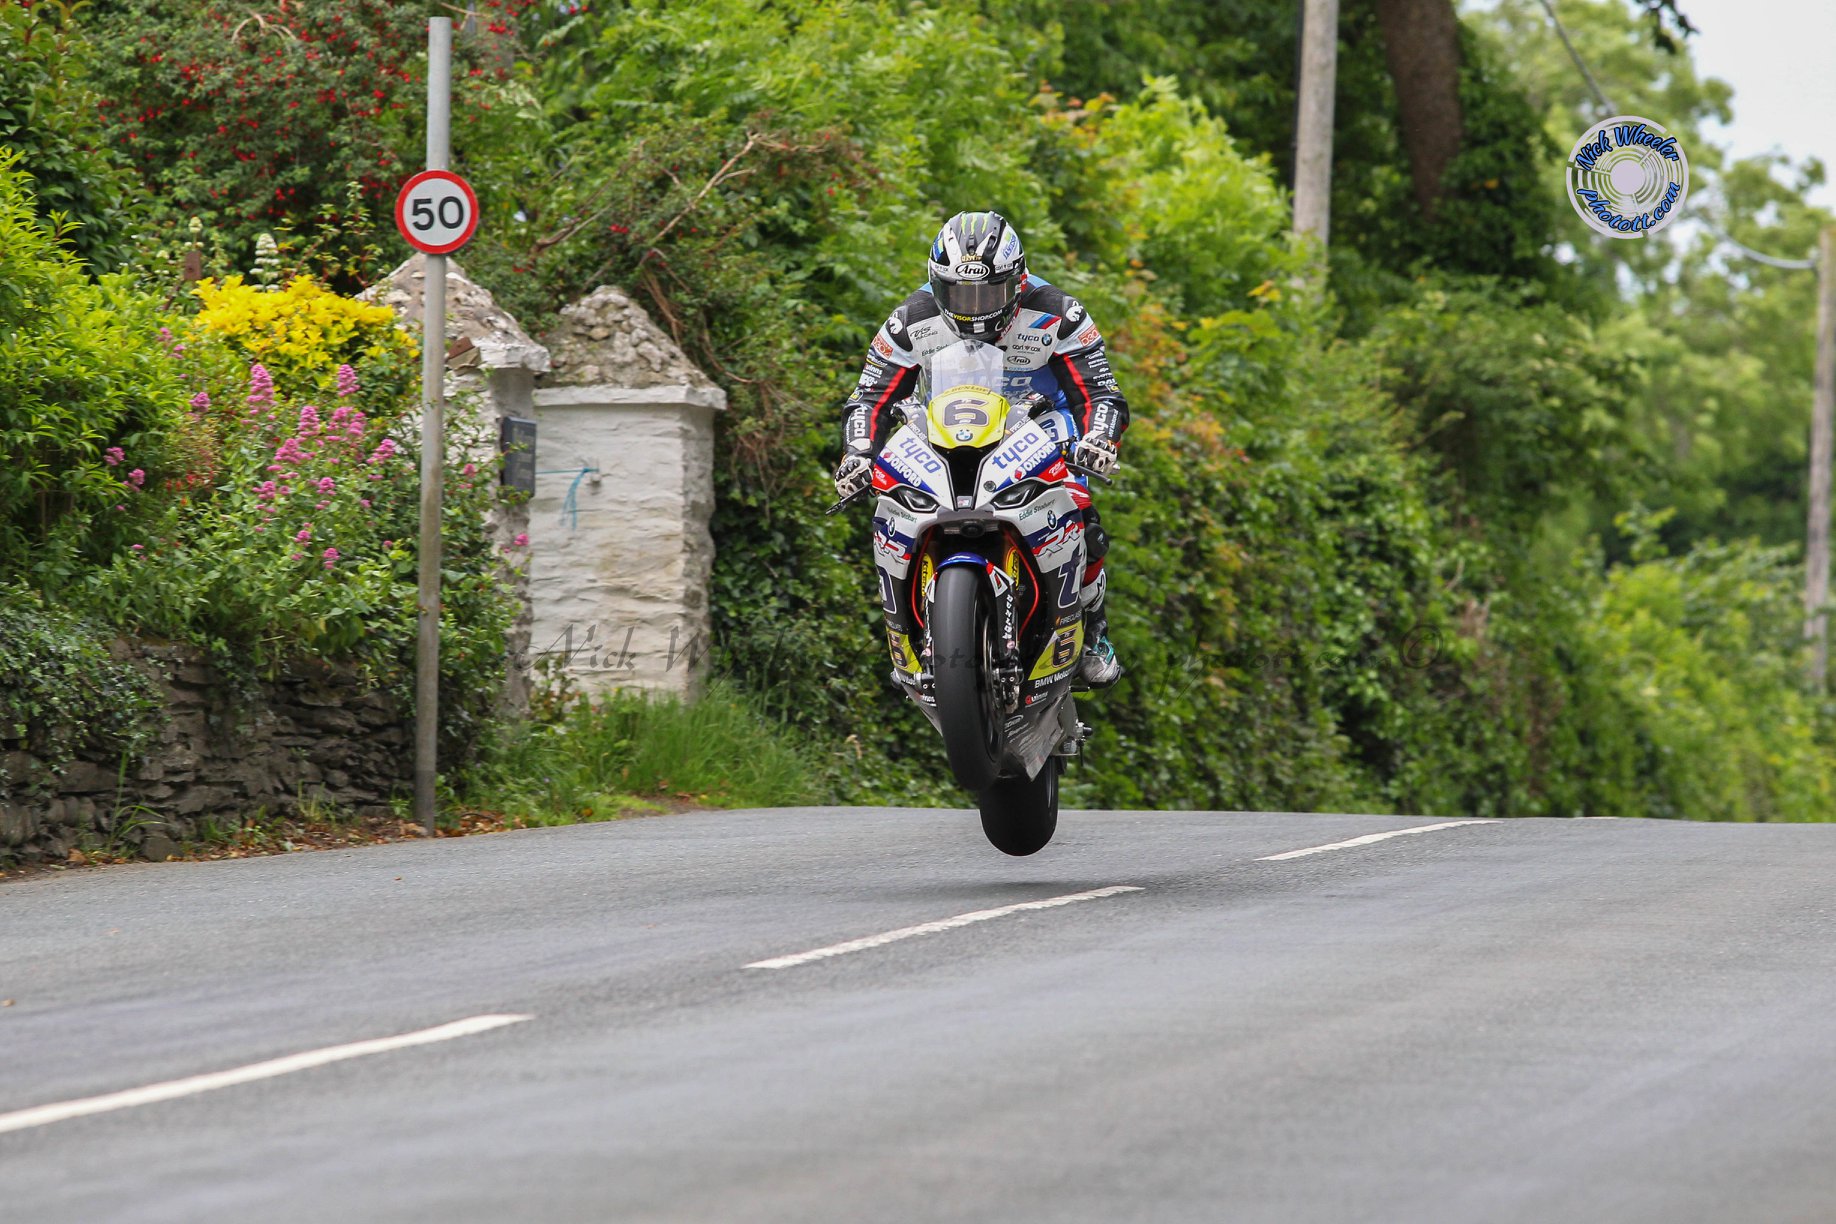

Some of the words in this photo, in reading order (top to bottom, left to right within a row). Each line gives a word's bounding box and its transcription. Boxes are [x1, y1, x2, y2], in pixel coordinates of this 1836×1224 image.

[412, 196, 464, 230] 50
[957, 264, 986, 275] Arai
[1017, 333, 1040, 342] tyco
[1008, 356, 1029, 364] Arai
[852, 404, 867, 437] tyco
[943, 399, 989, 428] 6
[899, 437, 942, 474] tyco
[991, 433, 1039, 469] tyco
[1023, 440, 1056, 472] OXFORD
[891, 456, 922, 488] OXFORD
[1018, 508, 1034, 521] Eddie
[1052, 627, 1077, 668] 6
[1034, 674, 1053, 689] BMW
